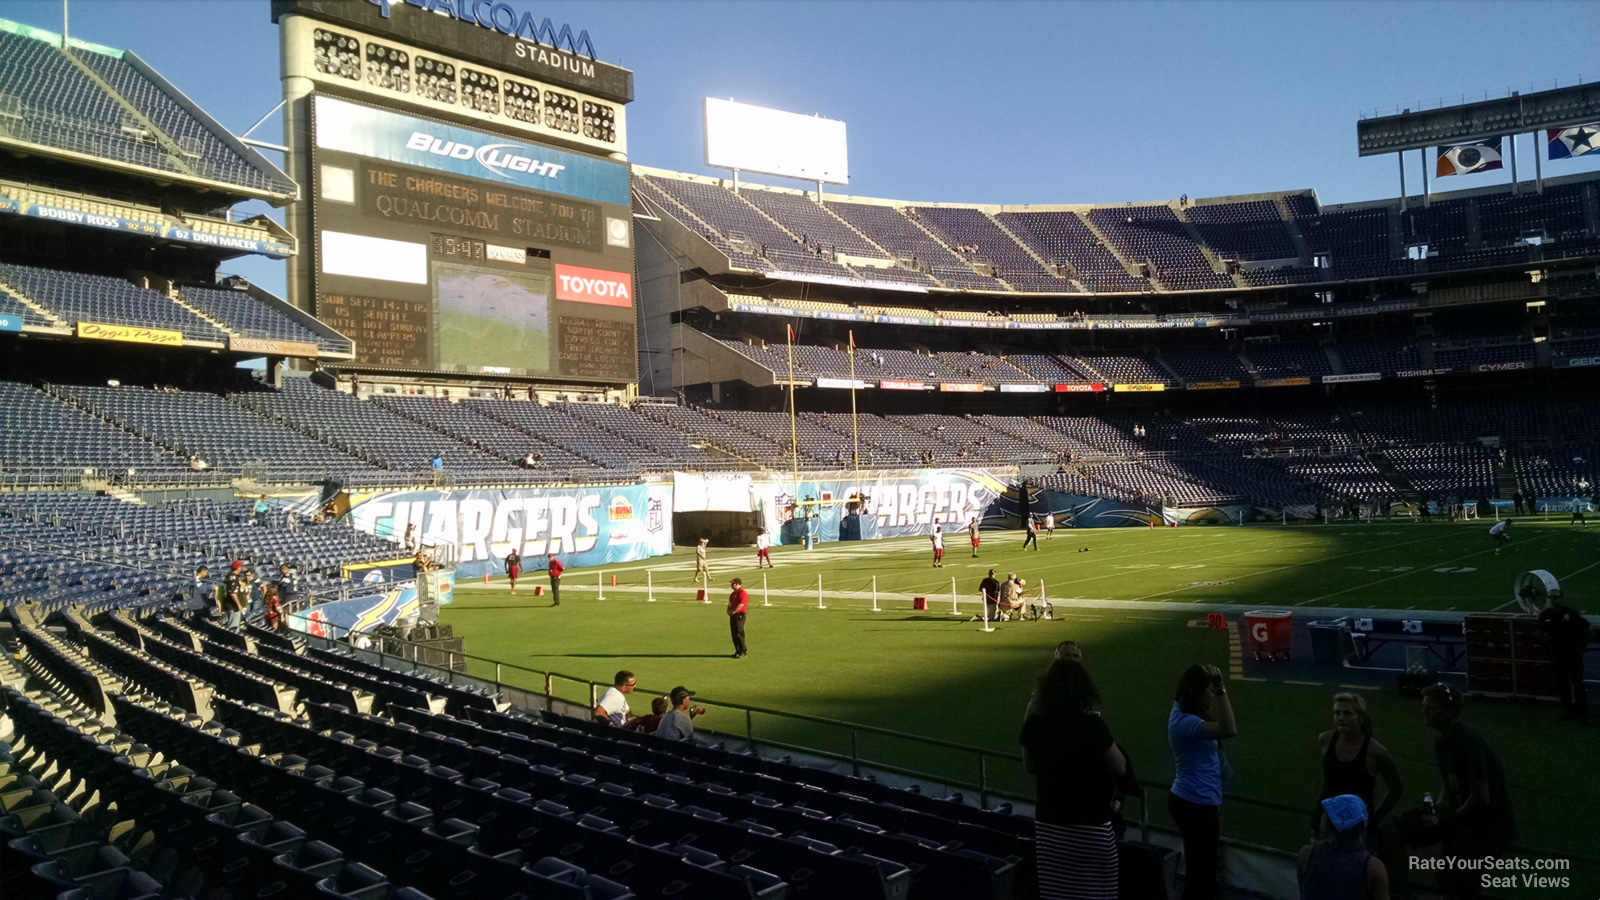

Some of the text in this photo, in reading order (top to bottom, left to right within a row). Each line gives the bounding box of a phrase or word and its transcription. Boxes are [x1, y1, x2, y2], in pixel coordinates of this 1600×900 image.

[368, 0, 597, 61] ALCOMM
[515, 42, 595, 78] STADIUM
[406, 132, 565, 178] BUD LIGHT
[368, 169, 397, 187] THE
[406, 176, 479, 201] CHARGERS
[486, 192, 544, 214] WELCOME
[551, 203, 574, 219] YOU
[39, 206, 83, 222] BOBBY
[86, 214, 119, 228] ROSS
[376, 194, 592, 246] QUALCOMM STADIUM
[175, 230, 189, 239] 62
[193, 232, 218, 245] DON
[219, 237, 258, 250] MACEK
[488, 248, 525, 260] SYCUAN
[559, 274, 628, 299] TOYOTA
[322, 294, 344, 305] SUN
[363, 310, 409, 322] SEATTLE
[82, 324, 177, 343] Oggi's Pizza
[233, 339, 277, 351] SYCUAN
[1396, 369, 1434, 377] TOSHIBA
[1478, 361, 1525, 372] CYMER
[354, 494, 601, 562] CHARGERS
[1209, 614, 1220, 628] 30
[1252, 622, 1269, 642] G
